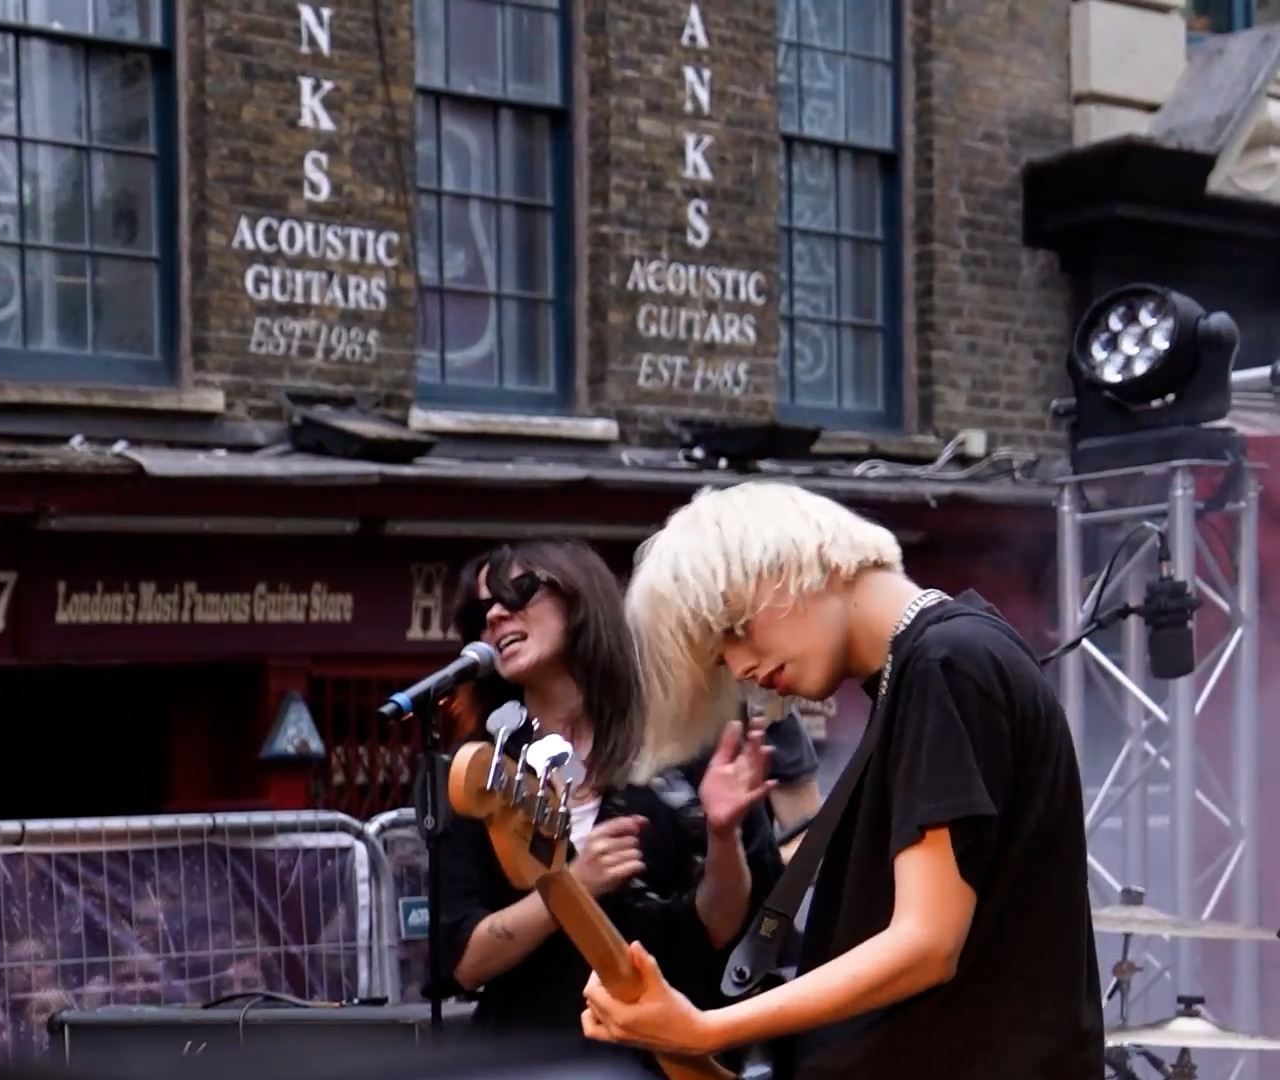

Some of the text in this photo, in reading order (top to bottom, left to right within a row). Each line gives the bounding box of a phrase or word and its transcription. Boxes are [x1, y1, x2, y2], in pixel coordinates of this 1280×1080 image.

[231, 213, 401, 267] ACOUSTIC
[244, 263, 388, 312] GUITARS
[626, 258, 767, 306] ACOUSTIC
[637, 303, 757, 346] GUITARS
[55, 580, 353, 624] London's Most Famous Guitar Store
